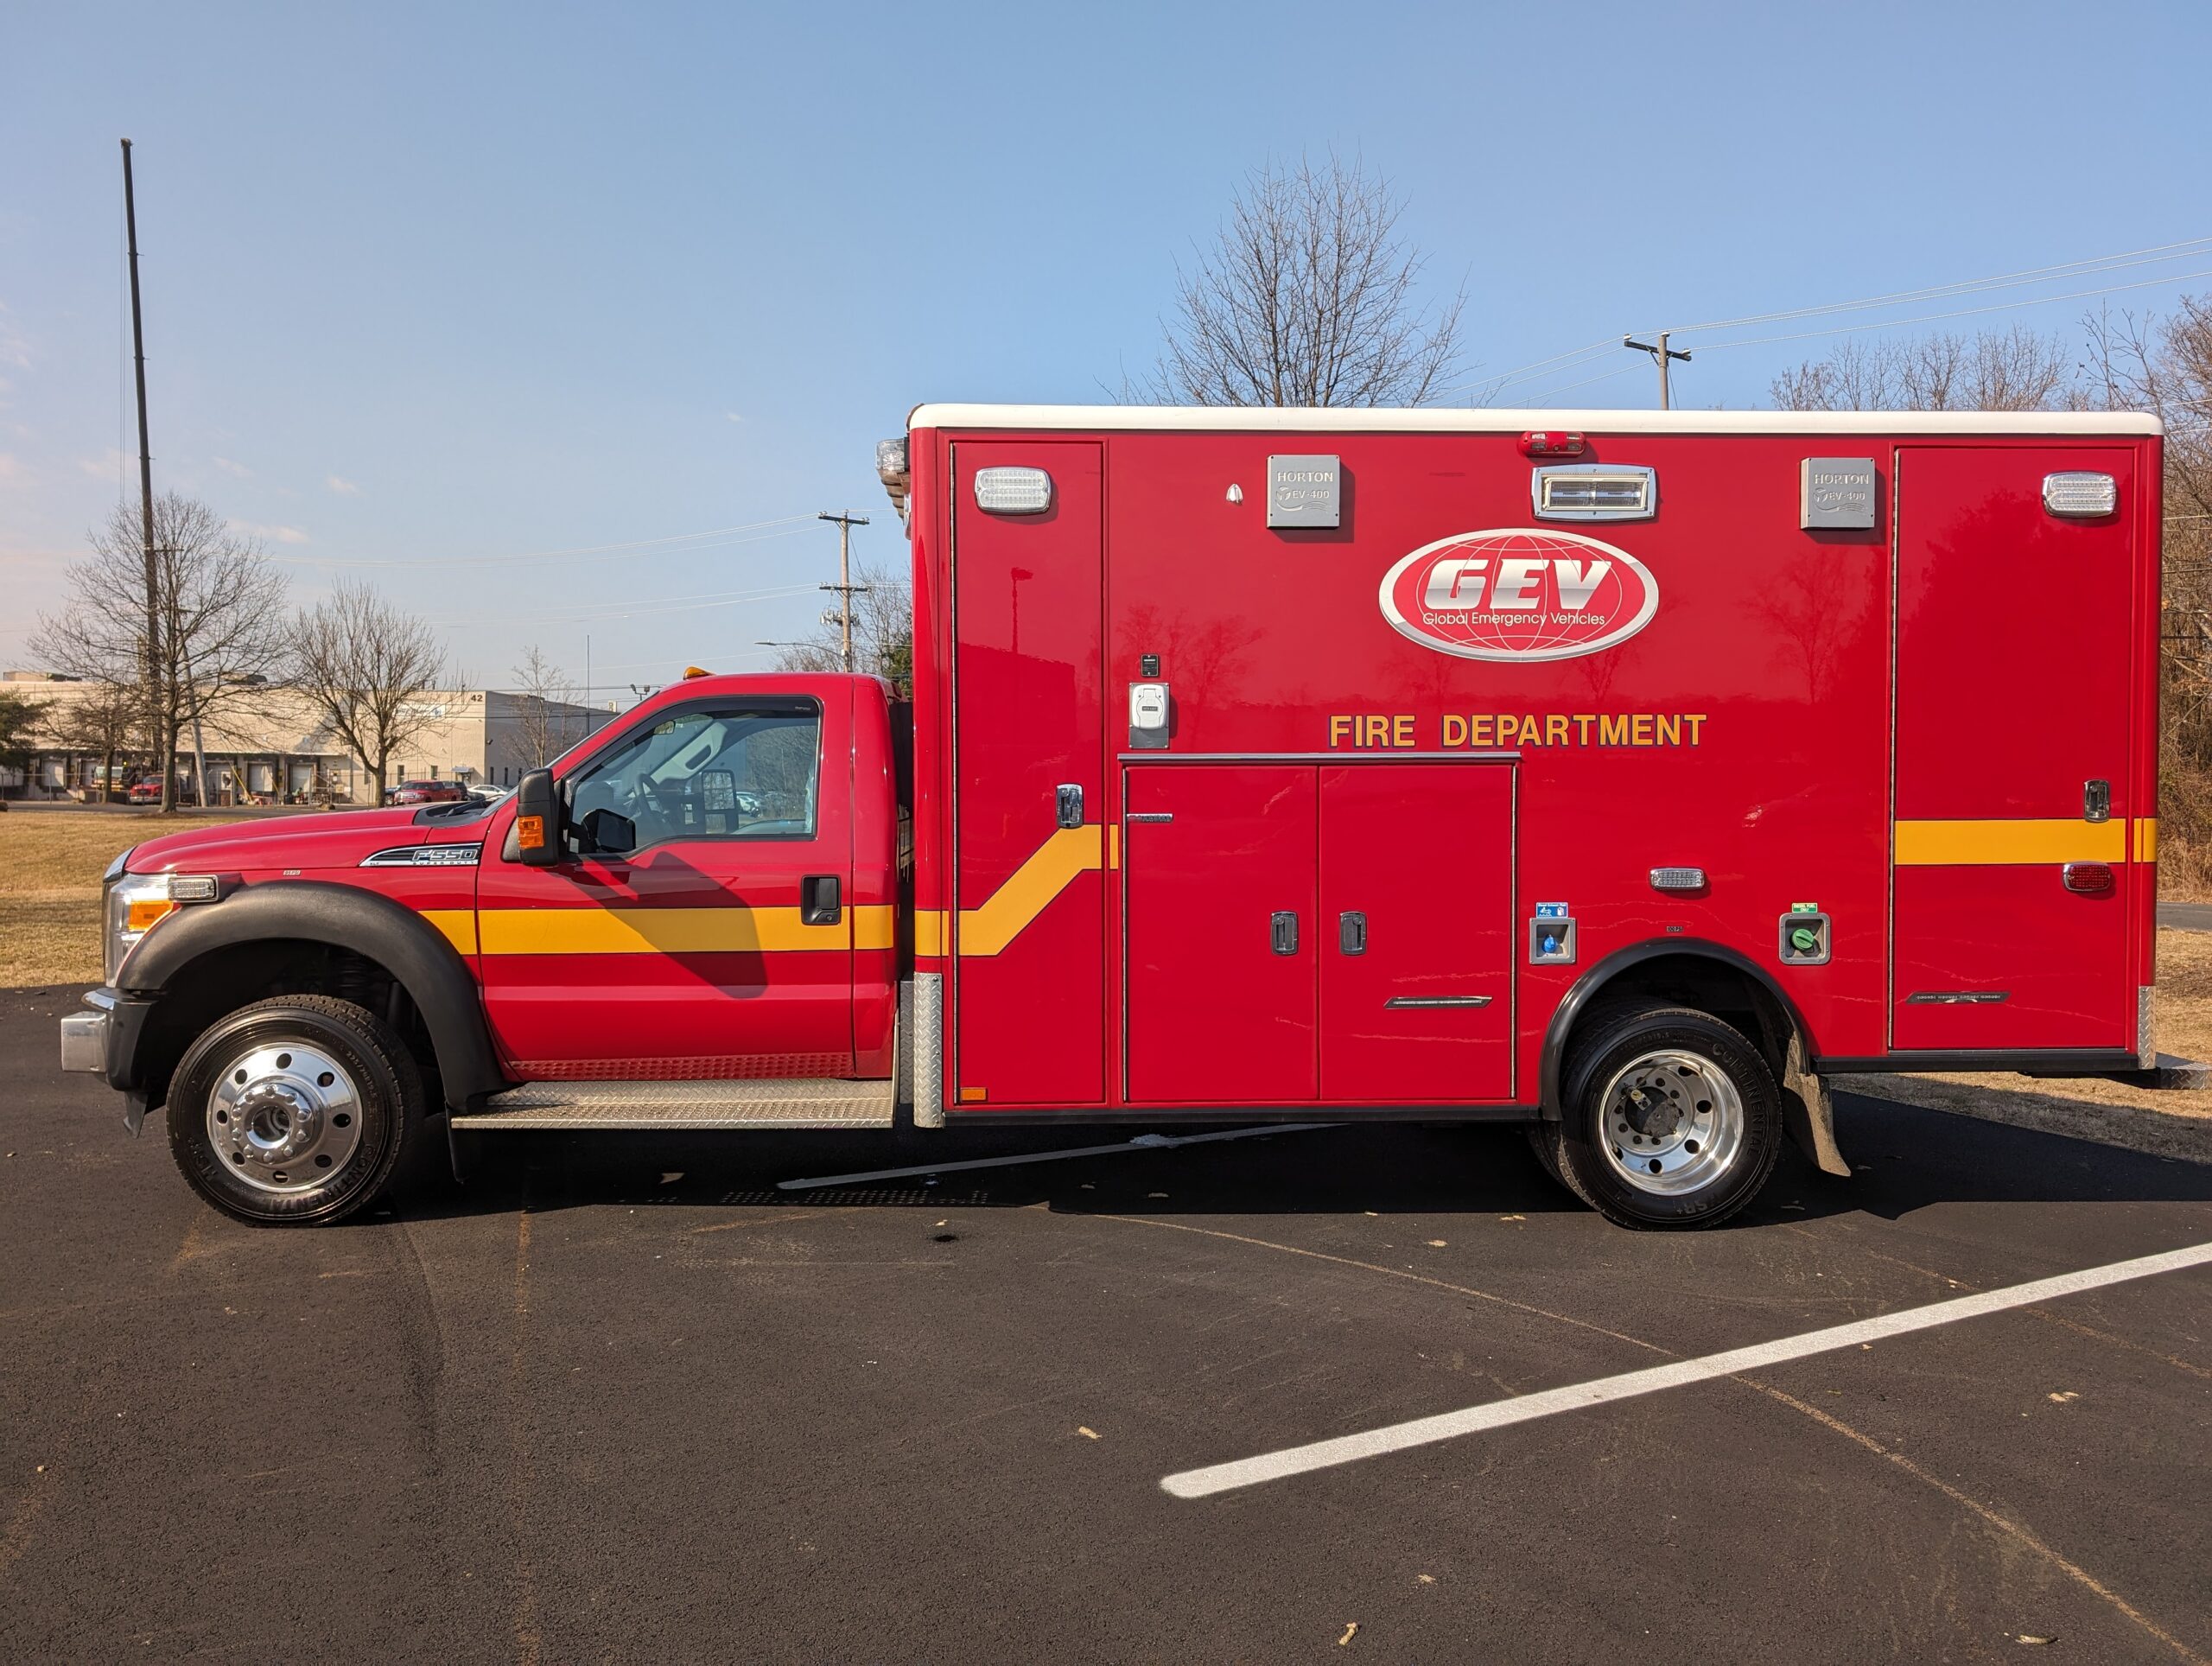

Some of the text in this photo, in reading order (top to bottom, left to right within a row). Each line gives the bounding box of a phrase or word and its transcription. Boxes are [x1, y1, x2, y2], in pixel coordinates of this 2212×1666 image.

[1277, 471, 1333, 482] HORTON
[1815, 474, 1869, 485] HORTON
[1292, 489, 1330, 499] EV-400
[1829, 491, 1866, 500] EV-400
[1424, 559, 1611, 610] GEV
[1422, 612, 1605, 627] Global Emergency Vehicles
[1329, 714, 1707, 747] FIRE DEPARTMENT
[1712, 1042, 1768, 1156] CONTINENTAL
